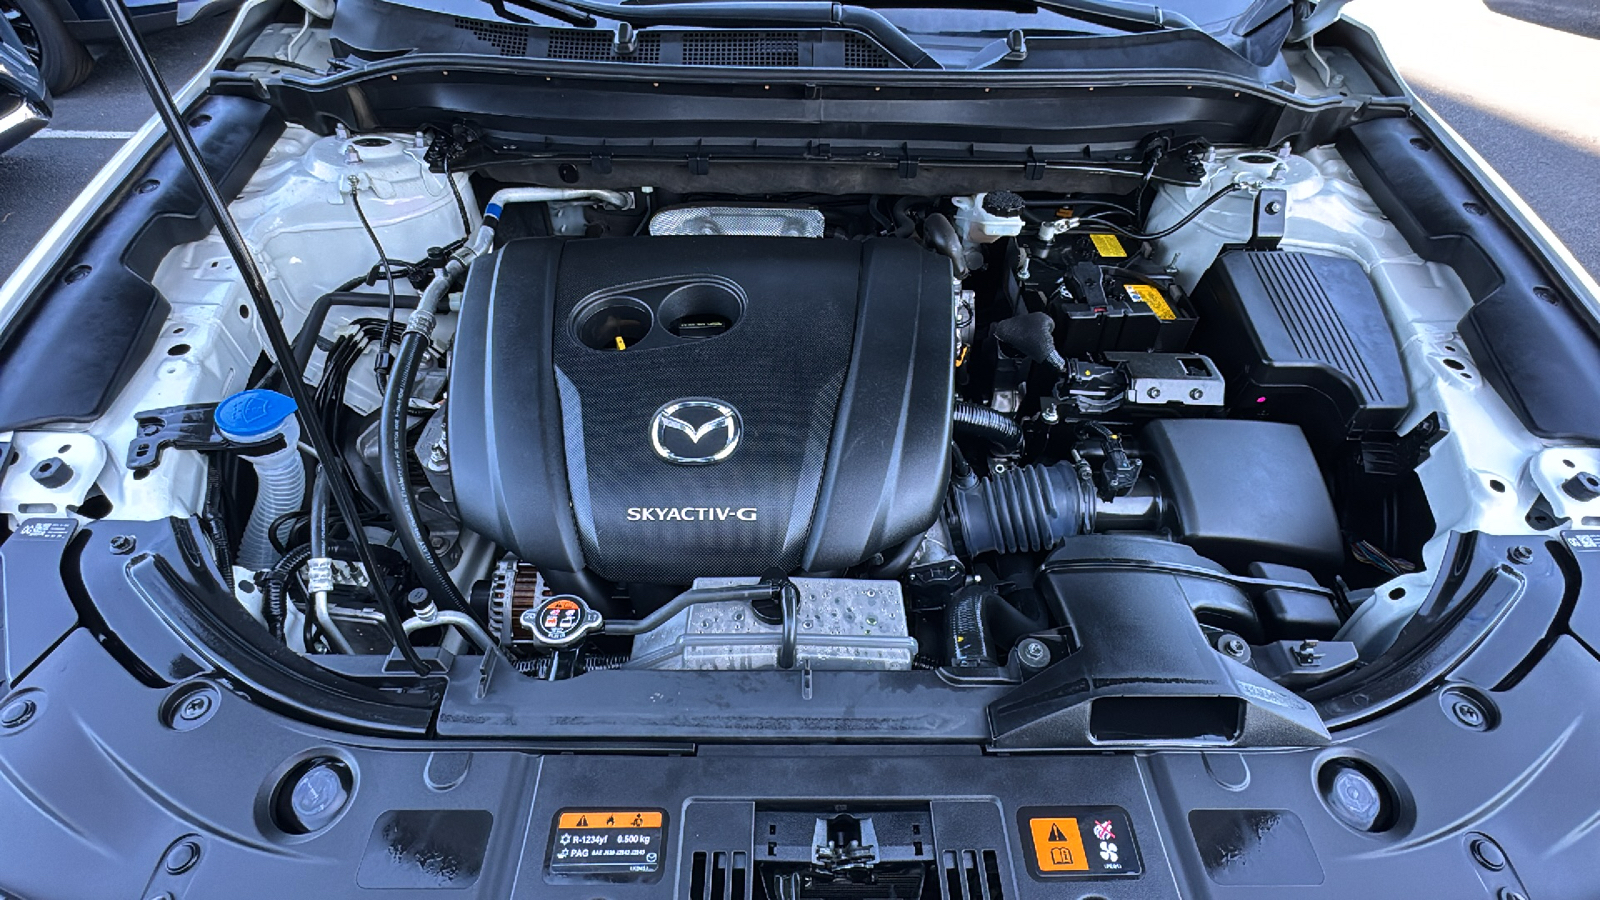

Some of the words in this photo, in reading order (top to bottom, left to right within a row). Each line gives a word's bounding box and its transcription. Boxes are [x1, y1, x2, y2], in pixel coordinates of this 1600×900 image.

[626, 506, 758, 521] SKYACTIV-G
[572, 834, 609, 845] R-1234yf
[617, 834, 639, 844] 0.500
[639, 834, 651, 845] kg
[570, 848, 589, 857] PAG
